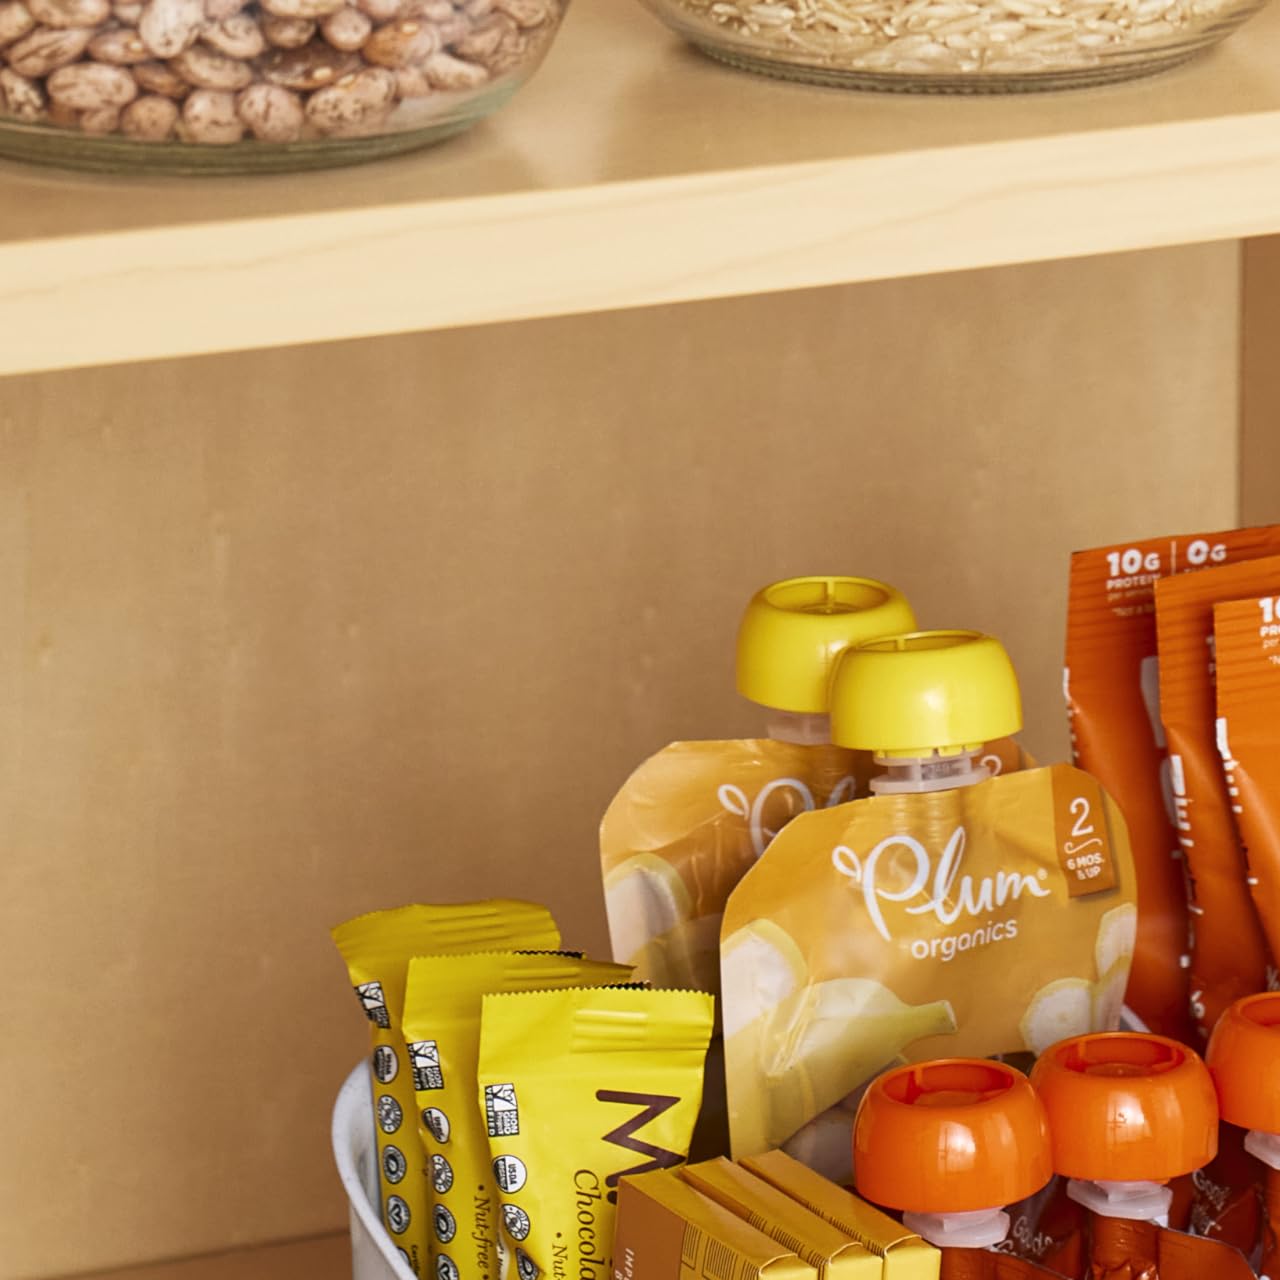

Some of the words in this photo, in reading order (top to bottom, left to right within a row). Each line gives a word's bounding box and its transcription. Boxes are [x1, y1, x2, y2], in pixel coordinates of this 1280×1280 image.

[1069, 797, 1095, 837] 2
[911, 919, 1018, 961] organics
[472, 1196, 491, 1270] Nut-free
